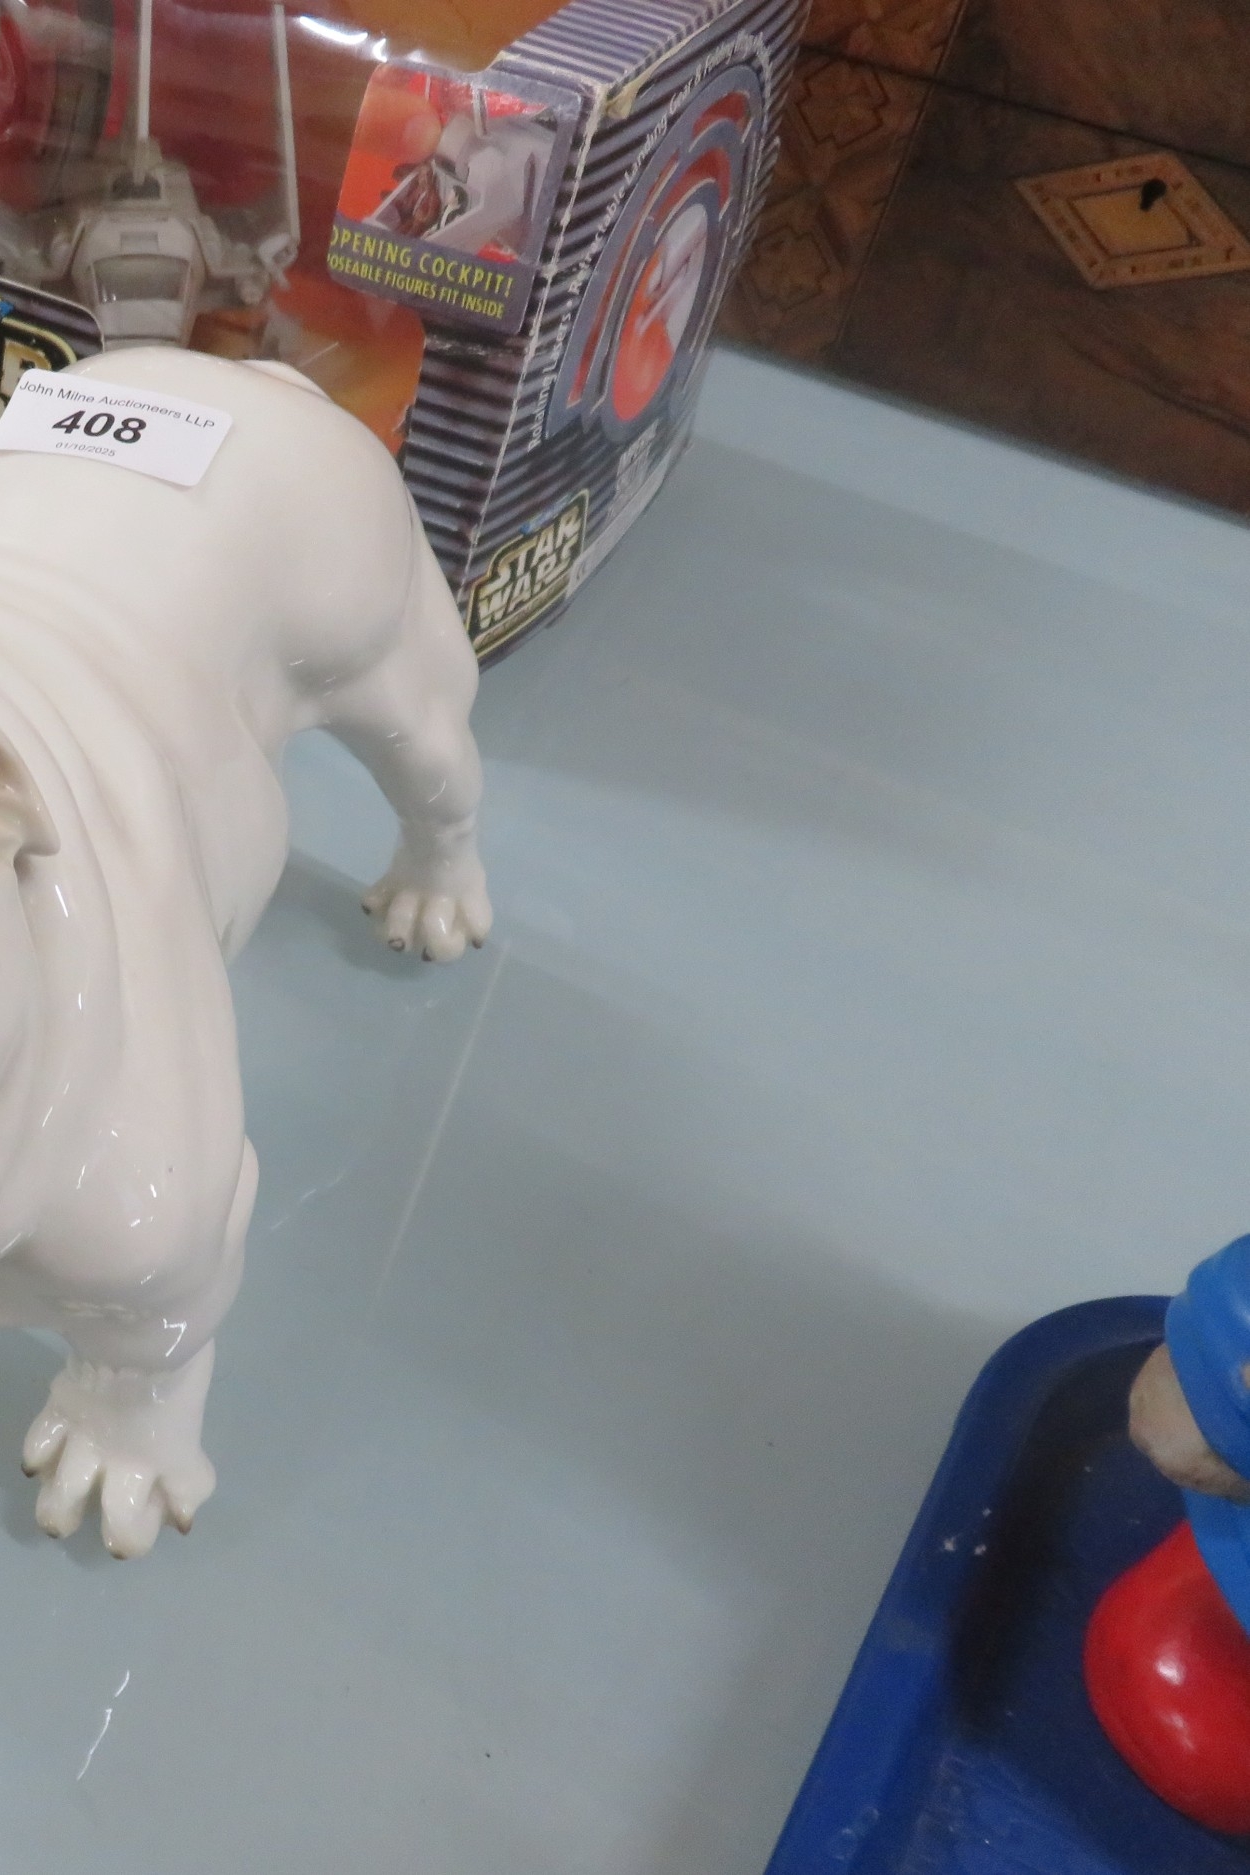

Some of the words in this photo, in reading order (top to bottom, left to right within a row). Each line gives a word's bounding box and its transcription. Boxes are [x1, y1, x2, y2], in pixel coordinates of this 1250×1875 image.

[327, 253, 383, 283] OSEABLE
[384, 271, 436, 301] FIGURES
[439, 286, 460, 306] FIT
[461, 292, 505, 320] INSIDE
[419, 252, 514, 299] COCKPIT!
[19, 380, 53, 397] John
[57, 388, 95, 404] Milne
[98, 395, 181, 419] Auctioneers
[185, 413, 215, 429] LLP
[51, 410, 147, 444] 408
[55, 441, 116, 457] 01/10/2025
[479, 503, 583, 600] STAR
[478, 533, 580, 630] WARS
